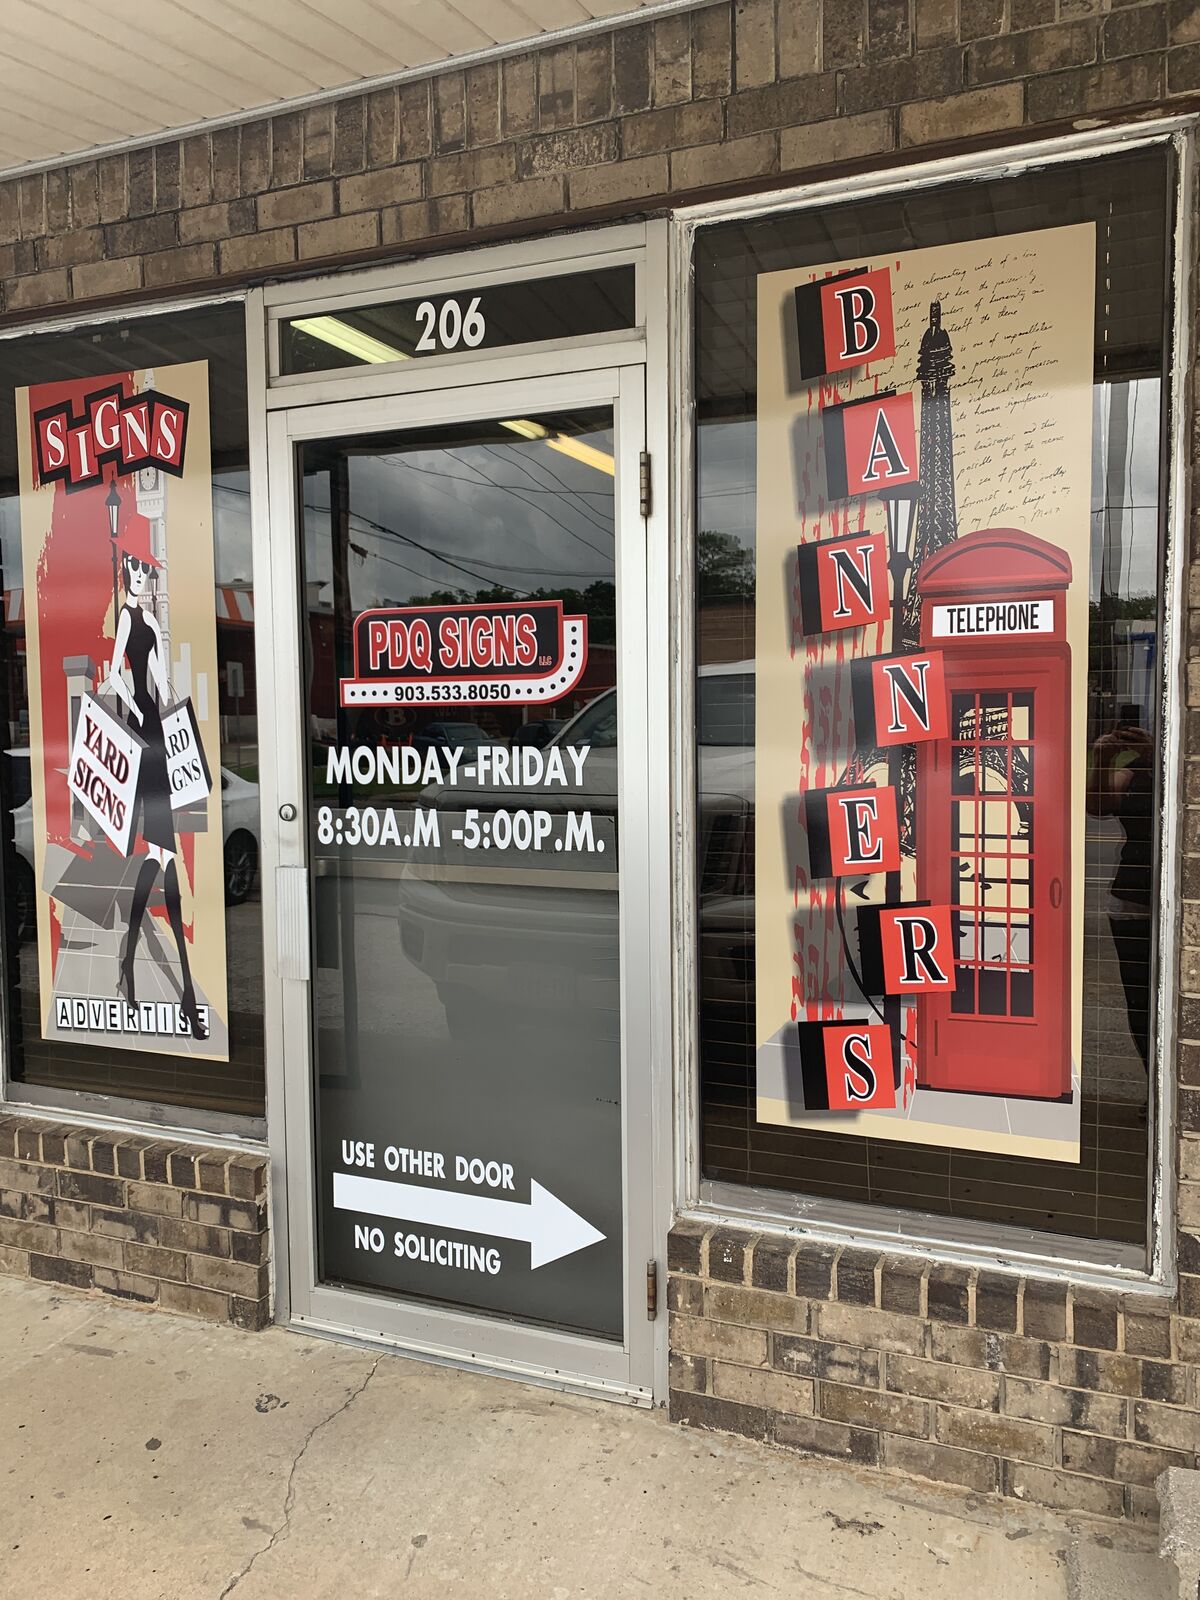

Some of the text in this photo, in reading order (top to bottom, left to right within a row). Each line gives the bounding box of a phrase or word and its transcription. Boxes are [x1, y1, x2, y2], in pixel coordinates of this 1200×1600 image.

[414, 296, 486, 352] 206
[46, 397, 178, 478] SIGNS
[368, 619, 432, 673] PDQ
[439, 613, 538, 668] SIGNS
[946, 603, 1040, 634] TELEPHONE
[394, 683, 512, 701] 903.533.8050
[828, 283, 949, 1103] BANNERS
[83, 714, 130, 785] YARD
[325, 745, 592, 787] MONDAY-FRIDAY
[73, 756, 127, 832] SIGNS
[317, 805, 441, 848] 8:30A.M
[341, 1139, 515, 1191] USE OTHER DOOR
[354, 1224, 501, 1275] NO SOLICITING
